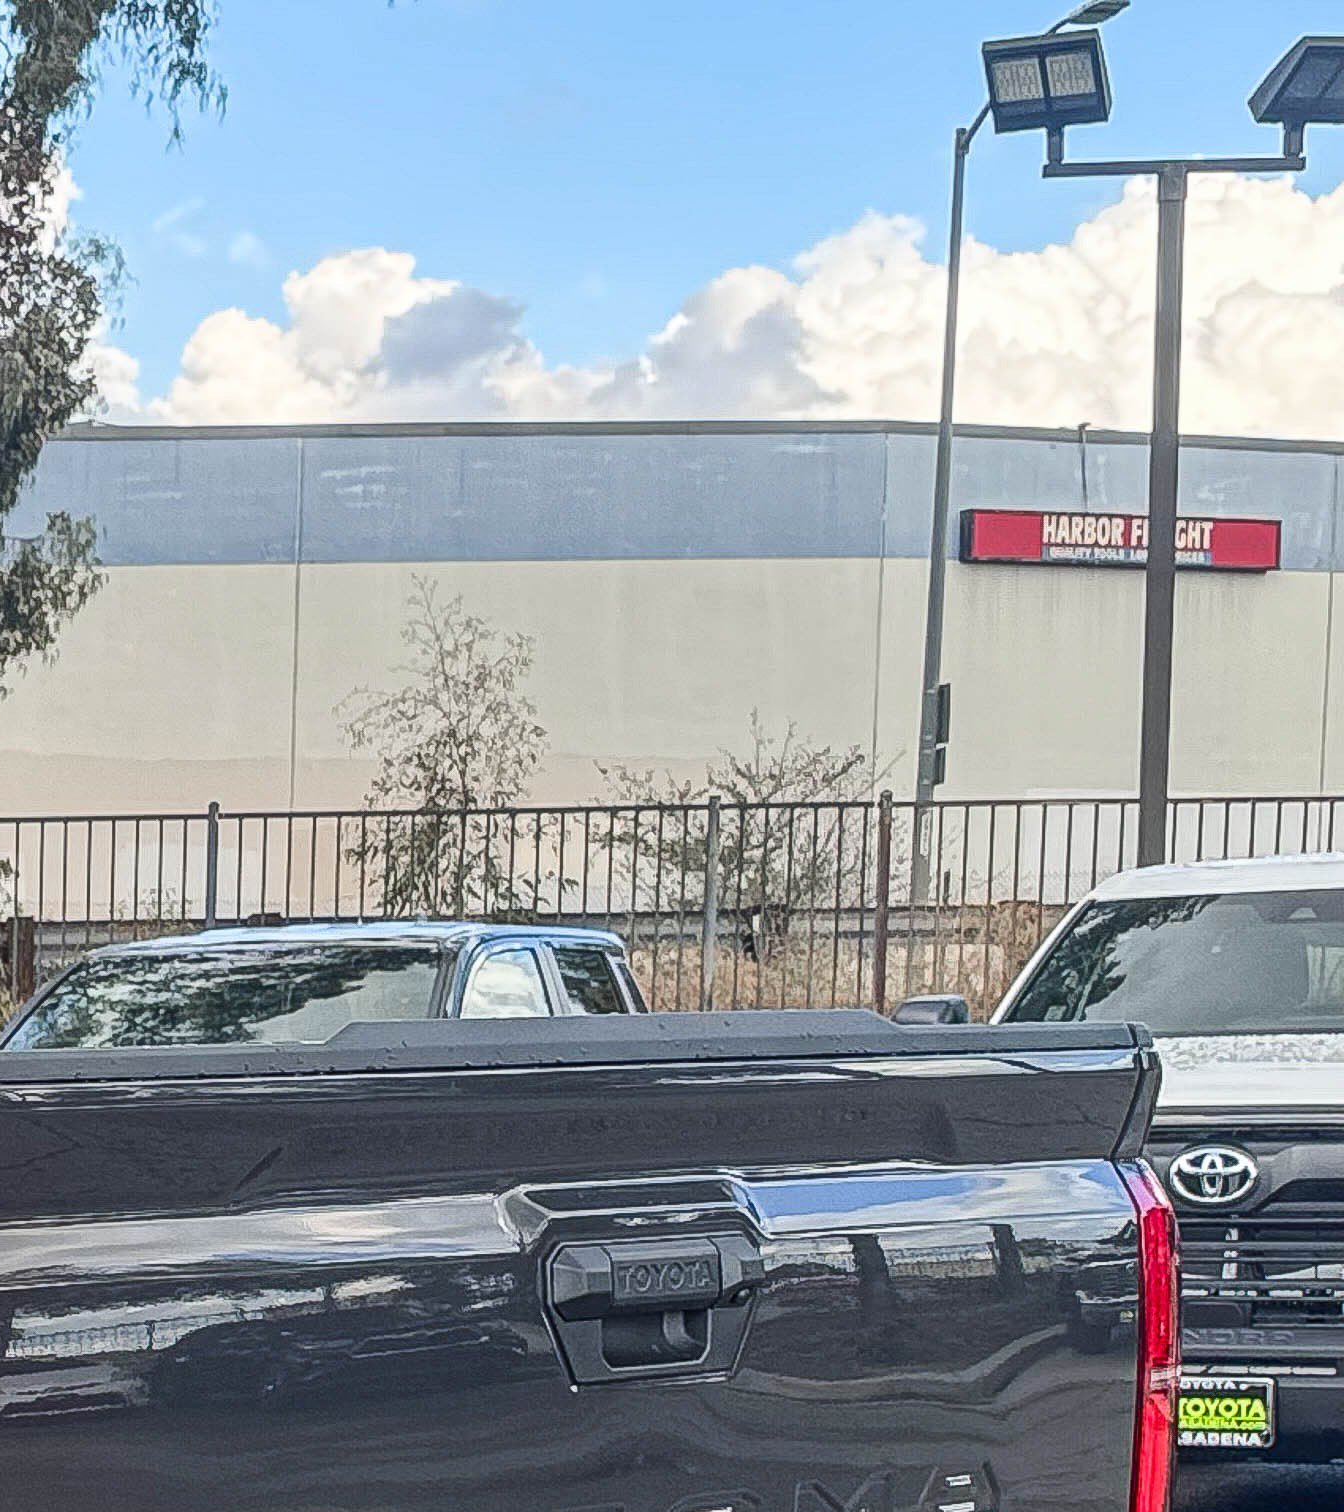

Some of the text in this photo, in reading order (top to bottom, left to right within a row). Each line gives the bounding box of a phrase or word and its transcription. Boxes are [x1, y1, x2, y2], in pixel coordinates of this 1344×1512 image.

[1042, 513, 1213, 550] HARBOR FGHT
[616, 1260, 712, 1293] TOYOTA
[1179, 1379, 1237, 1390] OYOTA
